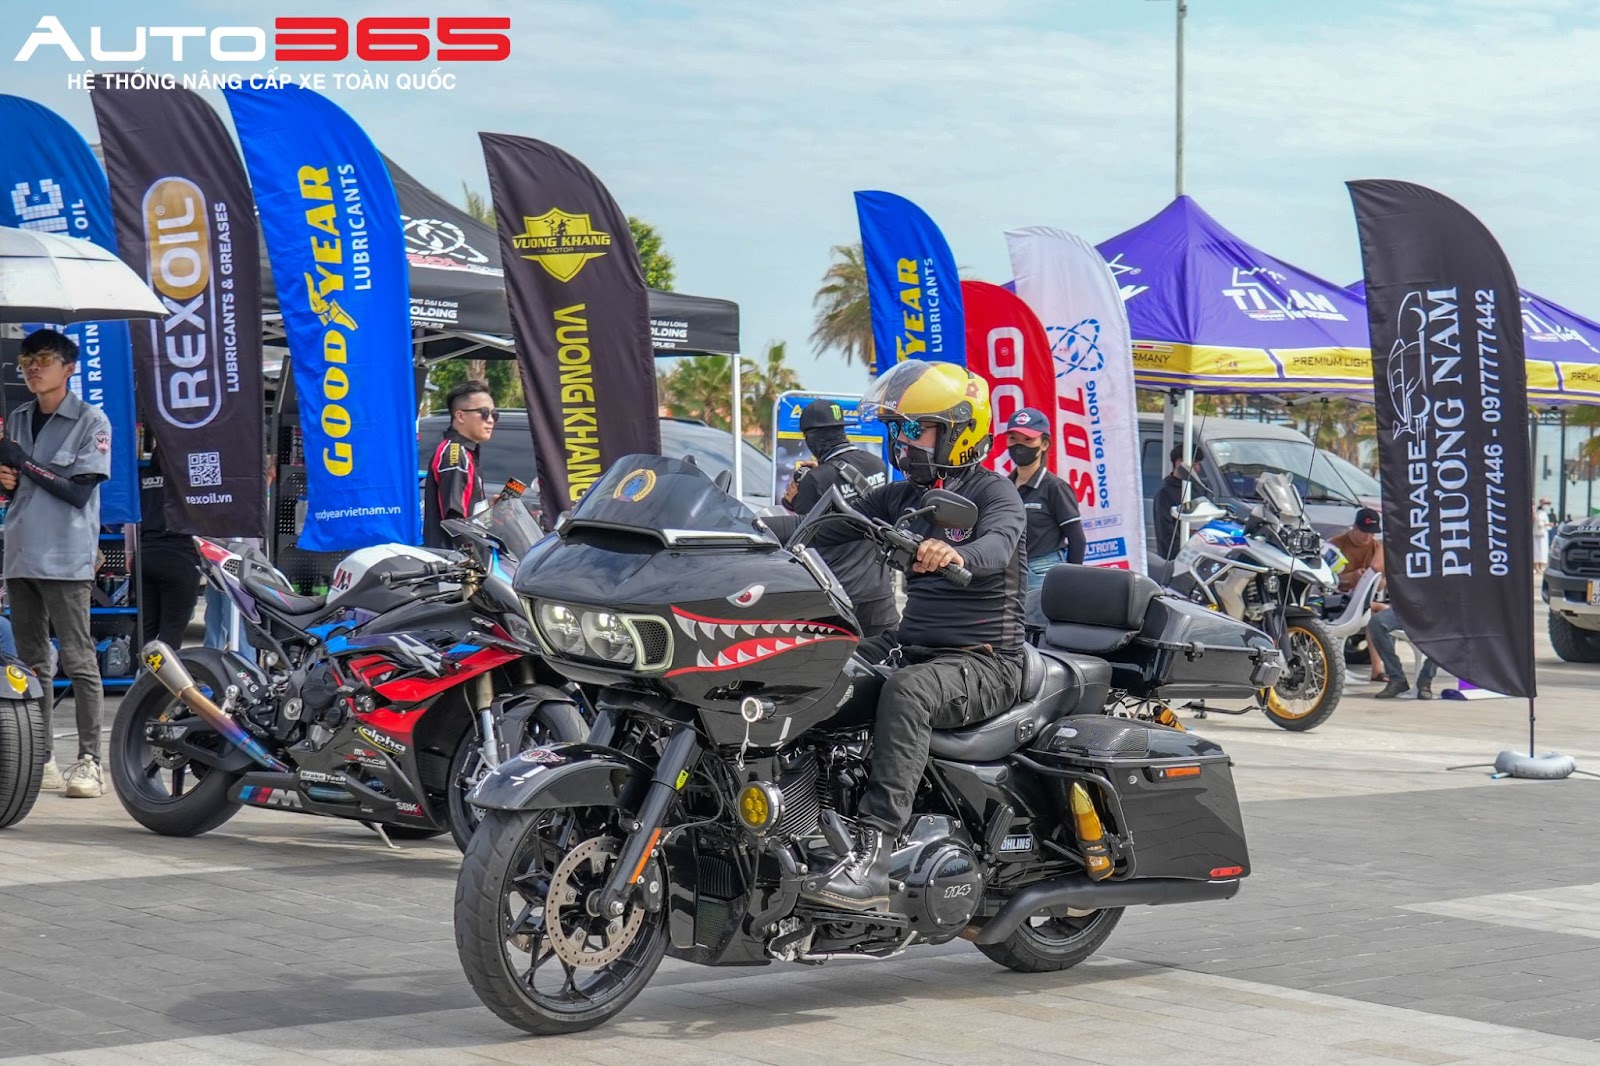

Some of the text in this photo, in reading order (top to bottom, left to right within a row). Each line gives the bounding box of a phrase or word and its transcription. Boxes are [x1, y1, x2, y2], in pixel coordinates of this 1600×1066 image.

[71, 199, 90, 230] OIL
[338, 163, 372, 291] LUBRICANTS
[512, 235, 611, 248] VUONG KHANG
[157, 197, 210, 409] REXOIL
[214, 202, 240, 392] LUBRICANTS & GREASES
[409, 305, 457, 319] OLDING
[897, 257, 926, 353] YEAR
[924, 257, 943, 353] LUBRICANTS
[410, 320, 444, 329] UPPLIER
[651, 327, 688, 338] LDING
[85, 324, 102, 381] RACIN
[1132, 352, 1170, 364] RMANY
[1293, 356, 1371, 366] PREMIUM LIGH
[1475, 289, 1501, 423] 0977777442
[1086, 380, 1101, 425] LONG
[1058, 387, 1096, 508] SDL
[1427, 287, 1472, 578] PHƯƠNG NAM
[1098, 463, 1110, 509] SONG
[1406, 440, 1432, 579] GARAGE
[1483, 444, 1508, 577] 0977777446
[361, 727, 407, 752] alpha
[325, 774, 347, 782] Tech
[944, 883, 971, 898] 114
